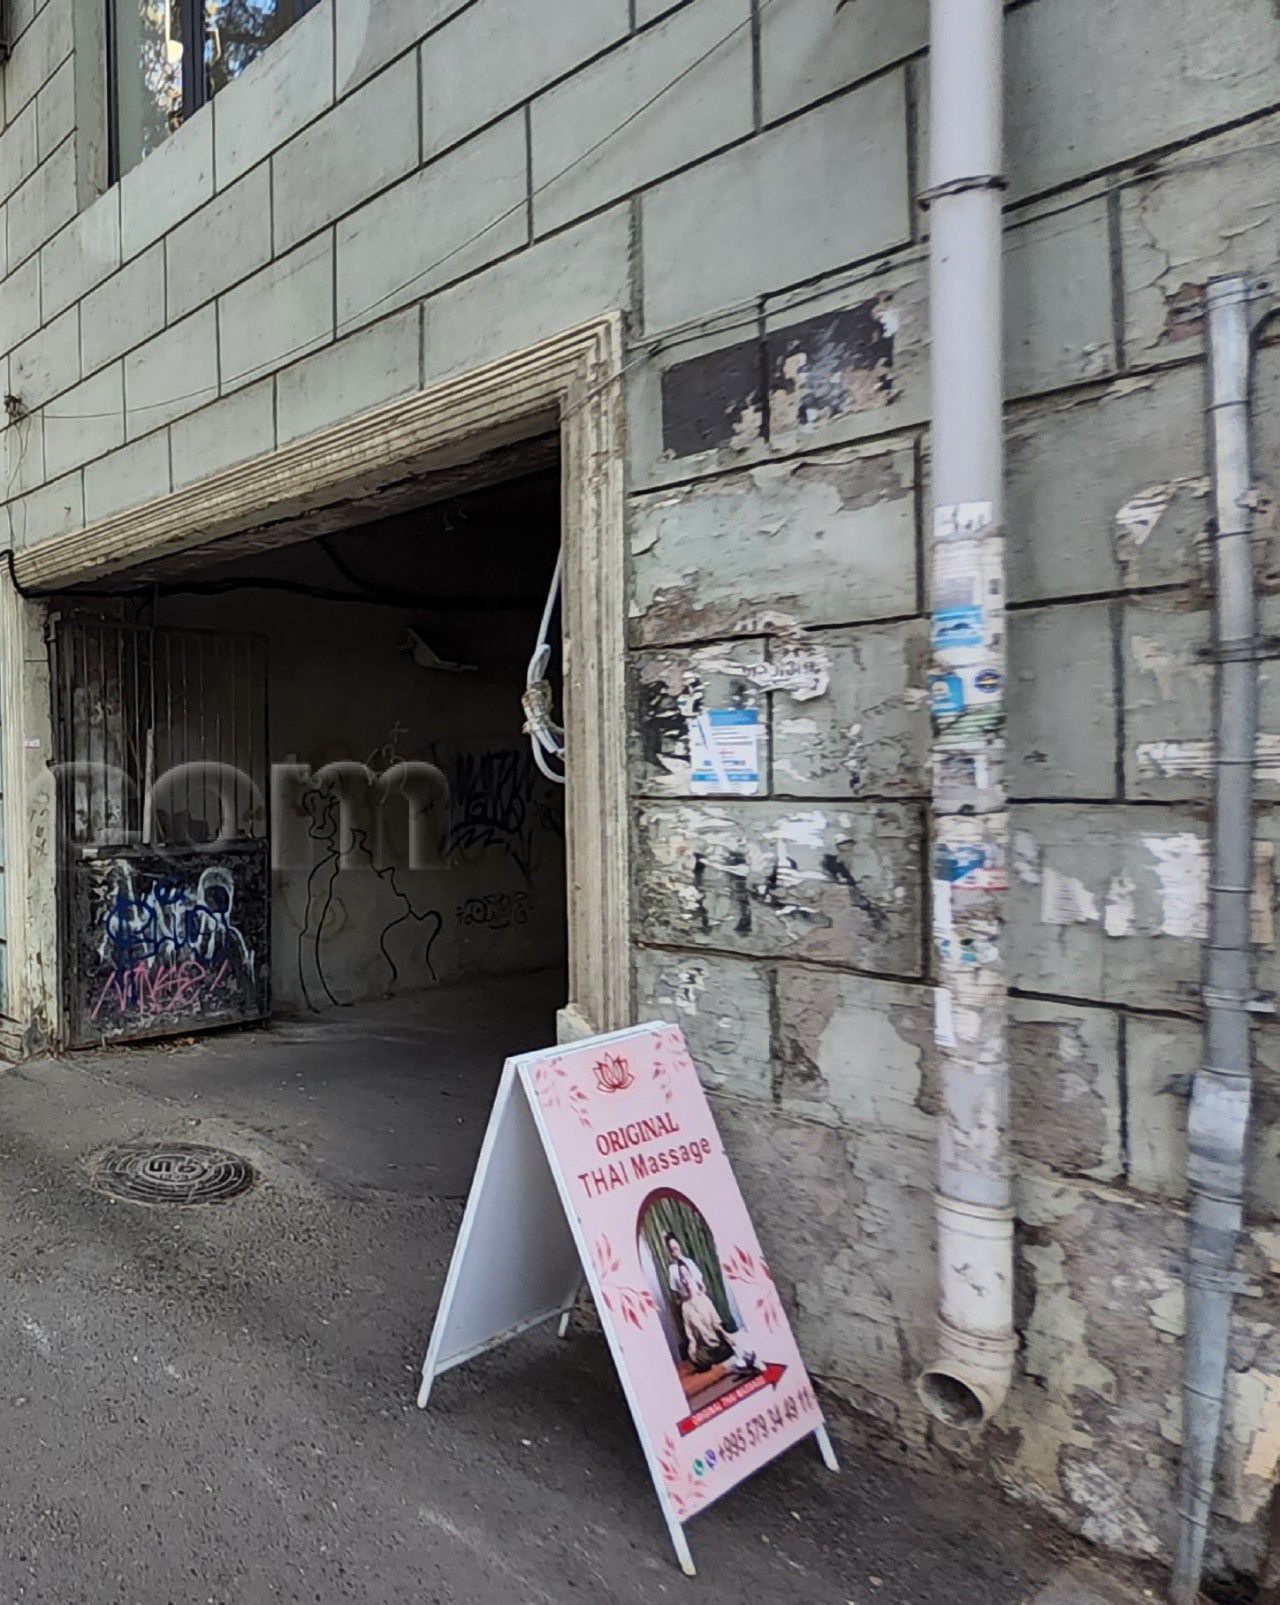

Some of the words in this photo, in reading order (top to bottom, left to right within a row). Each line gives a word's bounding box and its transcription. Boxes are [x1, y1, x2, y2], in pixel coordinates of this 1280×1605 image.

[596, 1112, 679, 1156] ORIGINAL
[577, 1160, 629, 1199] THAI
[631, 1137, 712, 1180] Massage
